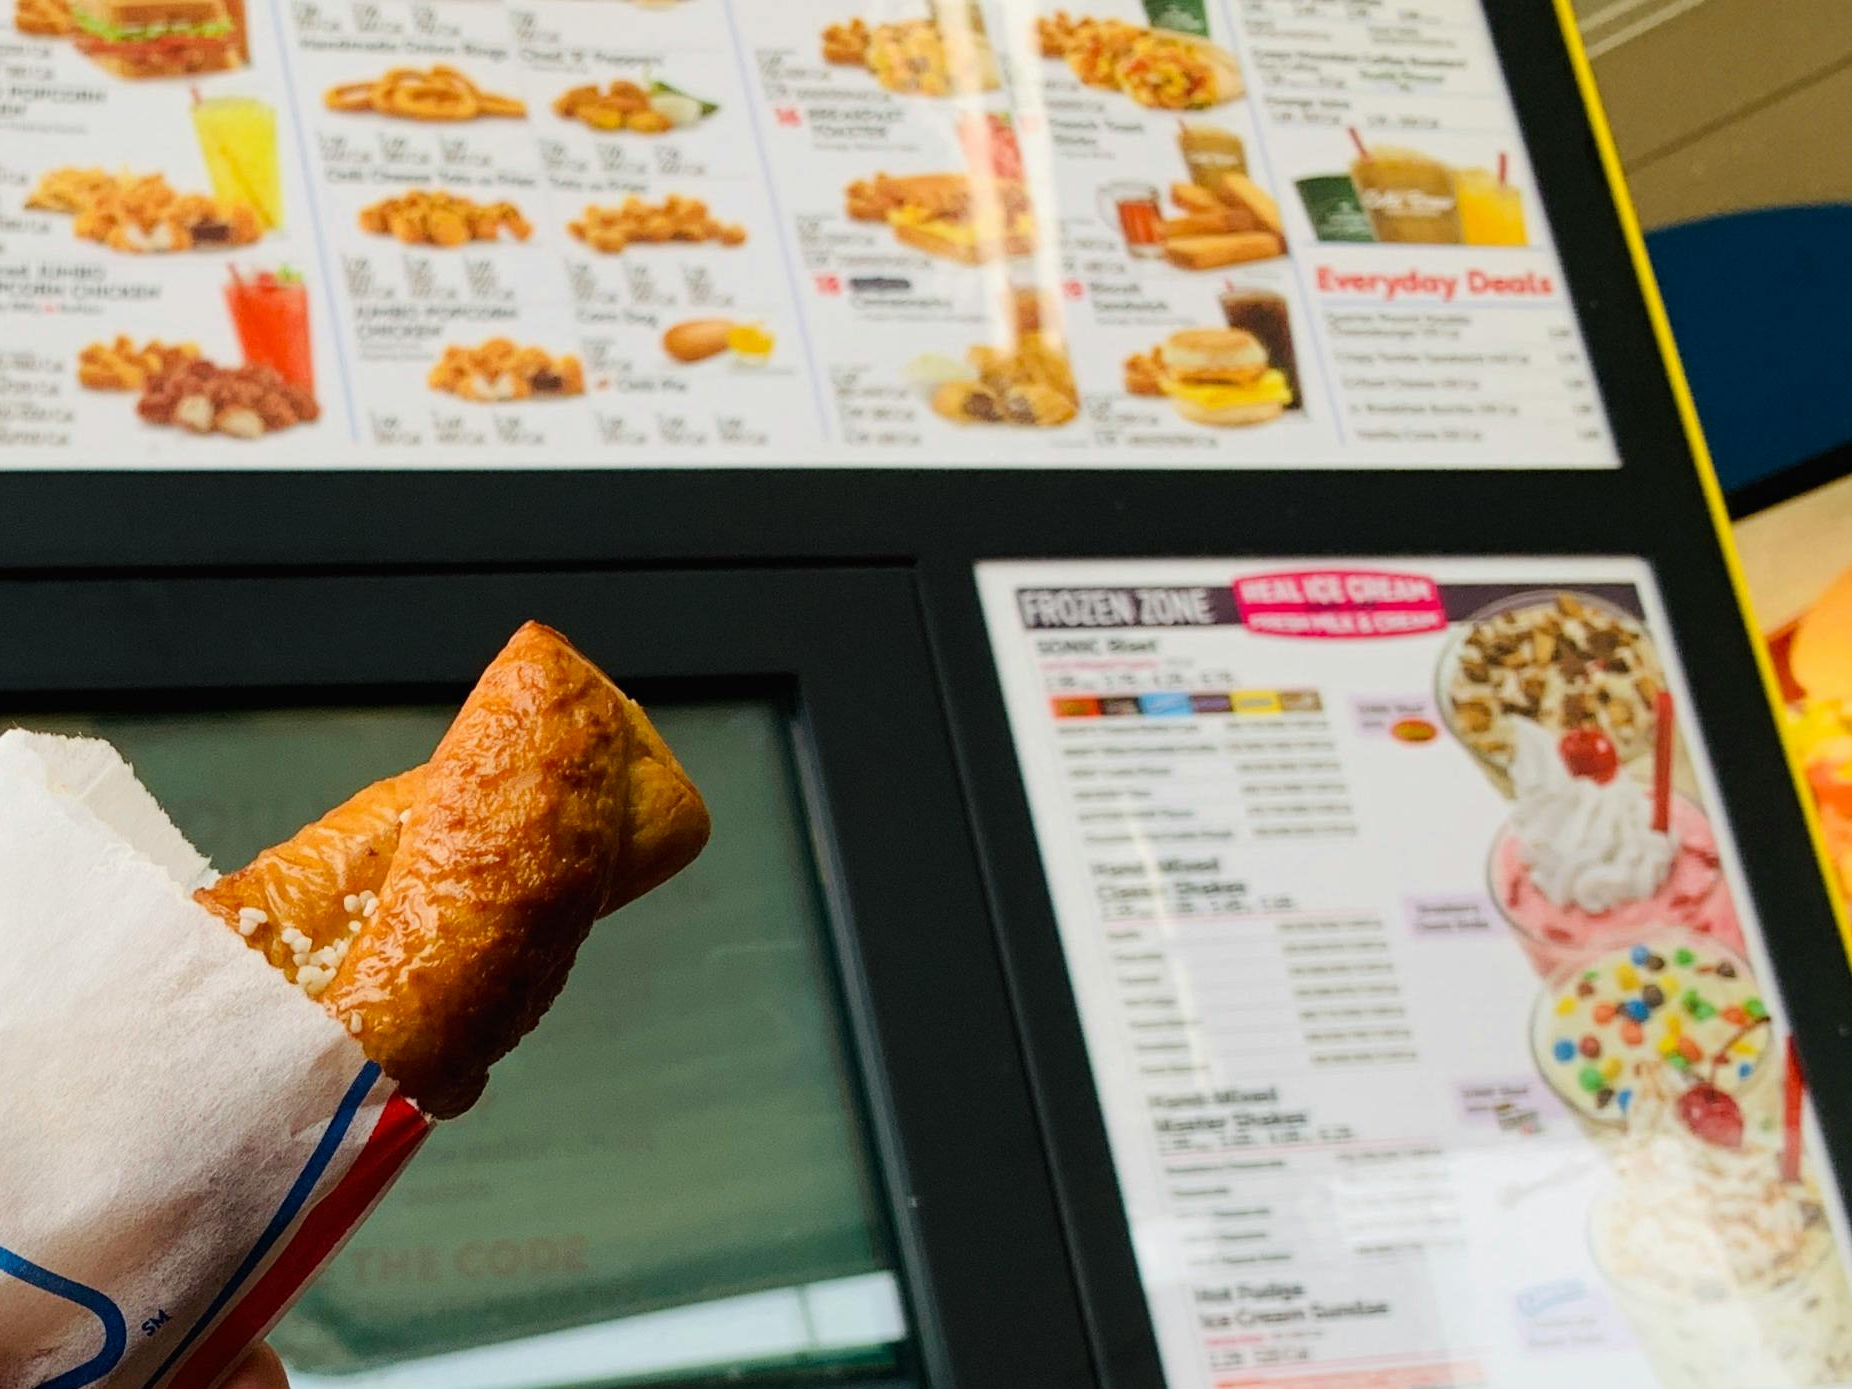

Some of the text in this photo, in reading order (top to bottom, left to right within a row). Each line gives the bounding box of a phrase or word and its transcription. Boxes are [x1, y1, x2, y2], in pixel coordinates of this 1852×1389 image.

[1316, 266, 1553, 302] Everyday Deals
[1021, 589, 1212, 627] FROZEN ZONE
[1240, 575, 1432, 605] REAL ICE CREAM
[454, 1234, 588, 1279] CODE
[141, 1308, 172, 1337] SM
